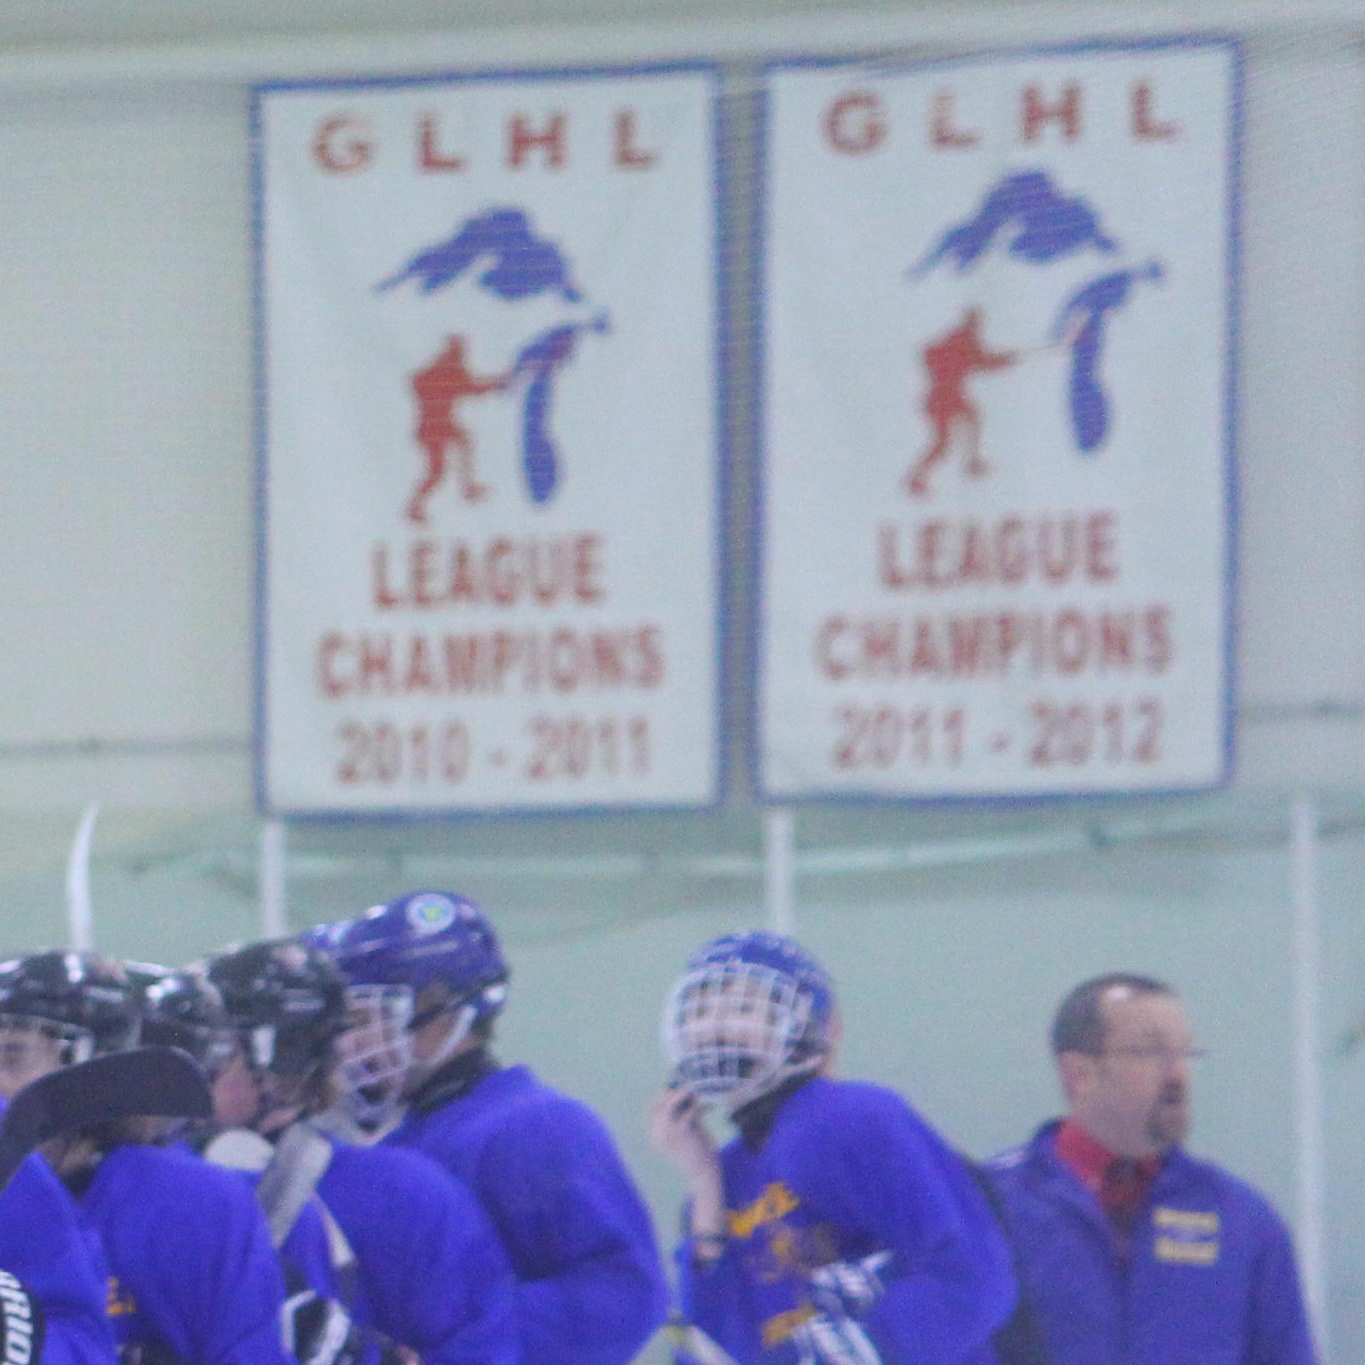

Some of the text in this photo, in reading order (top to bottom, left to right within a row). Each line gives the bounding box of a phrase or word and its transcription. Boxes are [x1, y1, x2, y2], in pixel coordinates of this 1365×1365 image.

[374, 533, 607, 611] LEAGUE
[881, 511, 1121, 592] LEAGUE
[317, 624, 666, 699] CHAMPIONS
[815, 604, 1175, 684] CHAMPIONS
[335, 717, 470, 788] 2010
[525, 715, 653, 783] 2011
[832, 700, 970, 772] 2011
[1027, 697, 1164, 769] 2012
